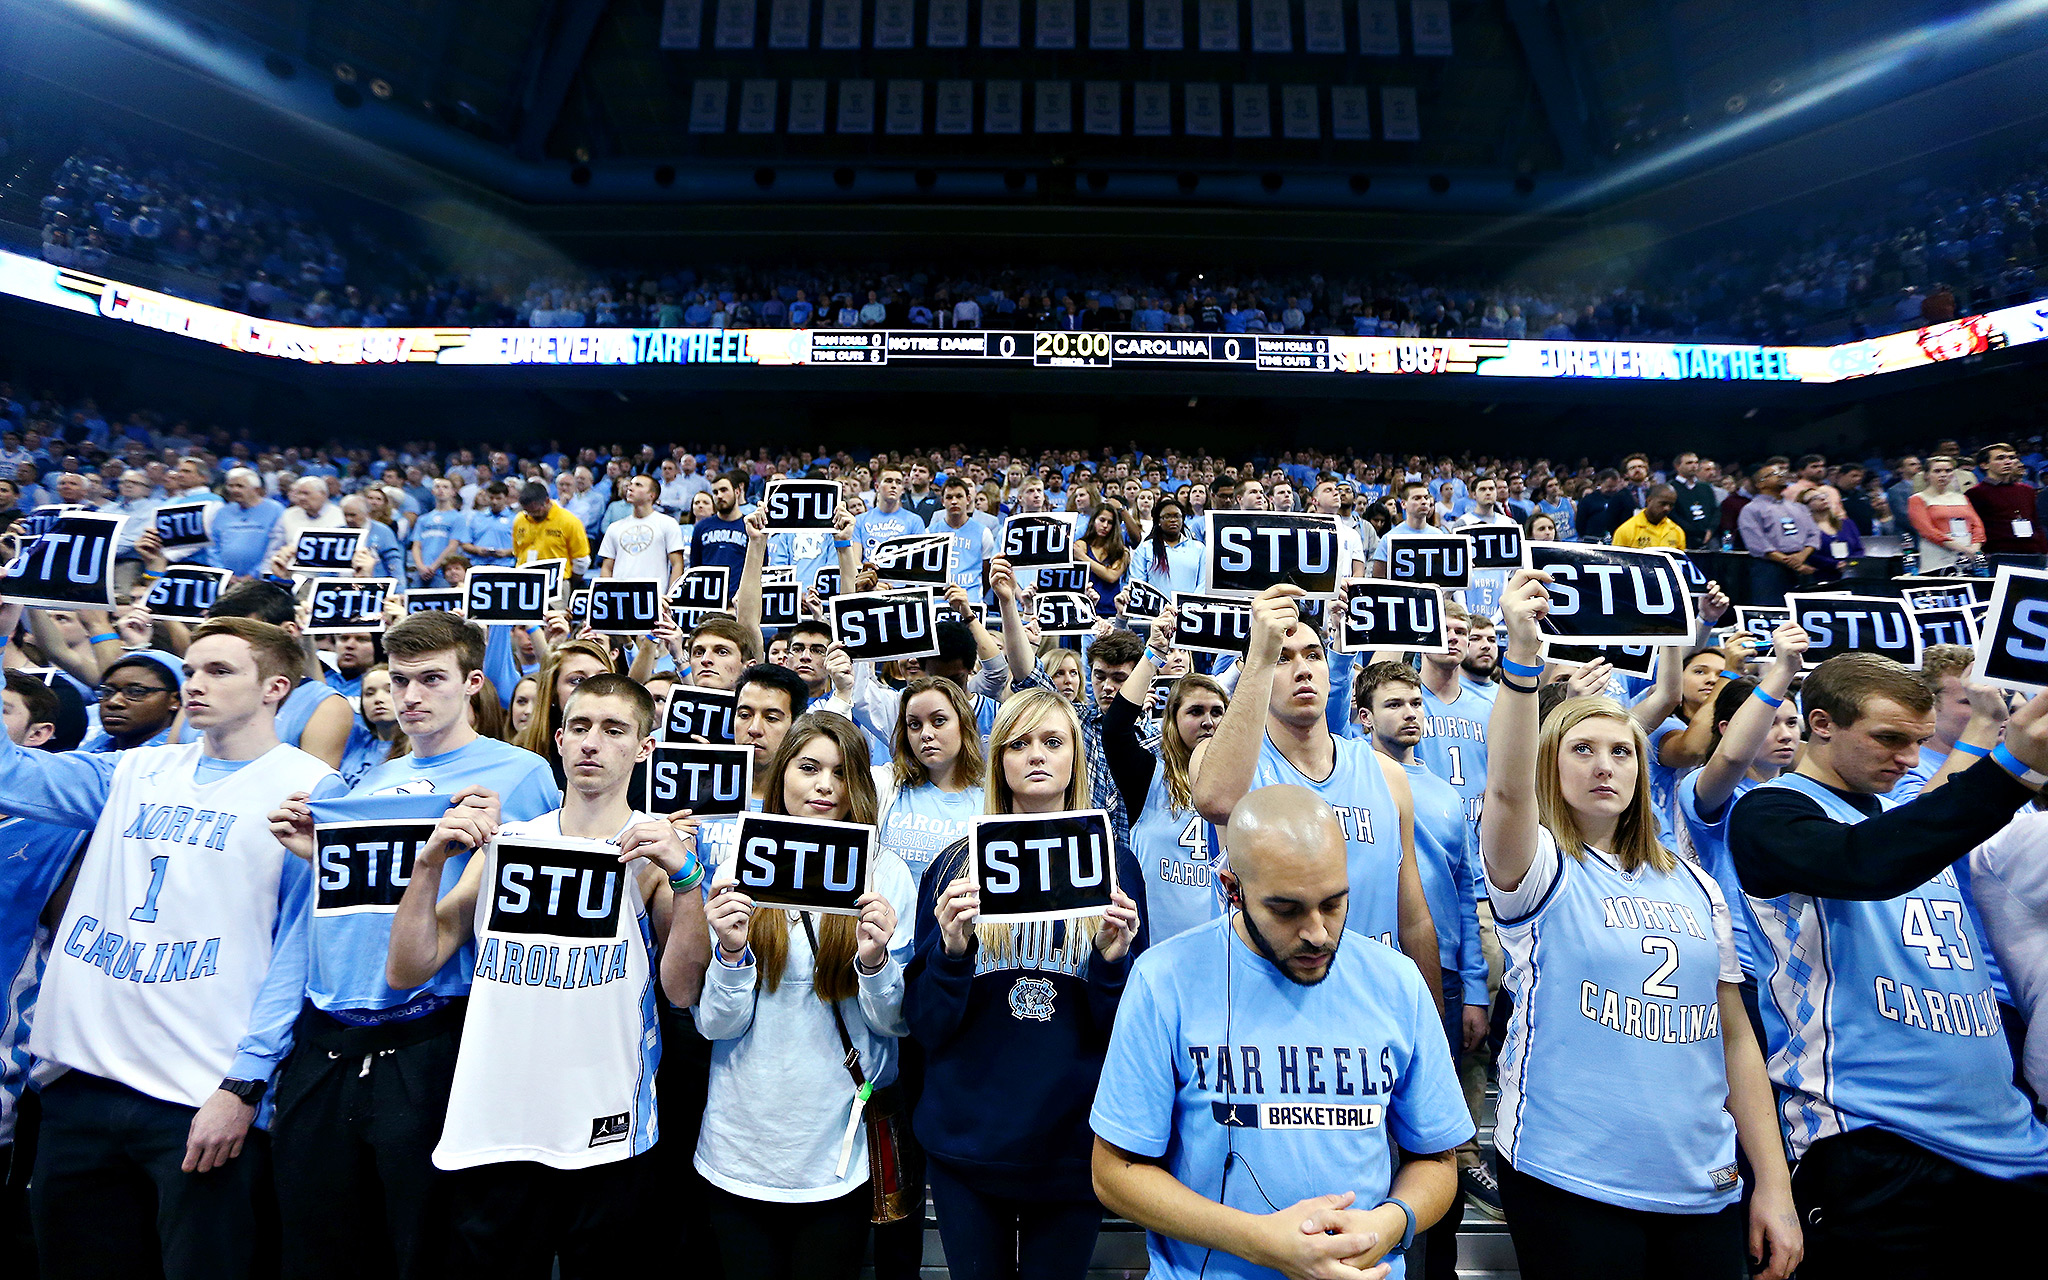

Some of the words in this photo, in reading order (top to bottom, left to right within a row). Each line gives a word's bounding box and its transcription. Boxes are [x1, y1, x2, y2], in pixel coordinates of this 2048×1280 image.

[632, 332, 683, 364] TAR
[872, 334, 881, 346] 0
[888, 336, 935, 352] NOTRE
[940, 337, 984, 351] DAME
[999, 335, 1016, 358] 0
[1036, 332, 1110, 357] 20:00
[1114, 339, 1208, 356] CAROLINA
[1224, 339, 1240, 361] 0
[1316, 340, 1326, 353] 0
[1390, 340, 1449, 374] 1987
[1674, 349, 1726, 379] TAR
[770, 493, 833, 520] STU
[159, 512, 202, 539] STU
[701, 529, 748, 547] CAROLINA
[297, 536, 357, 561] STU
[1006, 525, 1067, 556] STU
[1221, 527, 1332, 574] STU
[880, 543, 945, 572] STU
[1395, 548, 1464, 577] STU
[149, 577, 218, 608] STU
[1040, 568, 1084, 589] STU
[1542, 564, 1675, 615] STU
[313, 589, 384, 618] STU
[471, 582, 541, 611] STU
[592, 591, 655, 620] STU
[762, 593, 795, 616] TU
[1483, 589, 1493, 605] 5
[841, 602, 925, 648] STU
[1038, 602, 1095, 627] STU
[1350, 596, 1435, 634] STU
[1802, 611, 1907, 650] STU
[1422, 715, 1485, 744] NORTH
[1448, 746, 1465, 786] 1
[655, 761, 741, 801] STU
[123, 803, 238, 852] NORTH
[702, 823, 738, 844] TAR
[888, 812, 967, 836] CAROLI
[883, 827, 962, 852] BASKET
[321, 842, 426, 890] STU
[742, 837, 859, 892] STU
[985, 833, 1103, 894] STU
[129, 855, 170, 923] 1
[498, 863, 617, 919] STU
[1603, 895, 1706, 941] NORTH
[1903, 897, 1975, 971] 43
[64, 915, 221, 983] CAROLINA
[476, 938, 629, 990] AROLINA
[1641, 935, 1680, 1000] 2
[368, 1004, 423, 1023] ARMOUR
[1580, 980, 1719, 1045] CAROLINA
[1188, 1045, 1265, 1095] TAR
[1277, 1045, 1394, 1096] HEELS
[1268, 1106, 1374, 1127] BASKETBALL
[1713, 1172, 1730, 1183] XL
